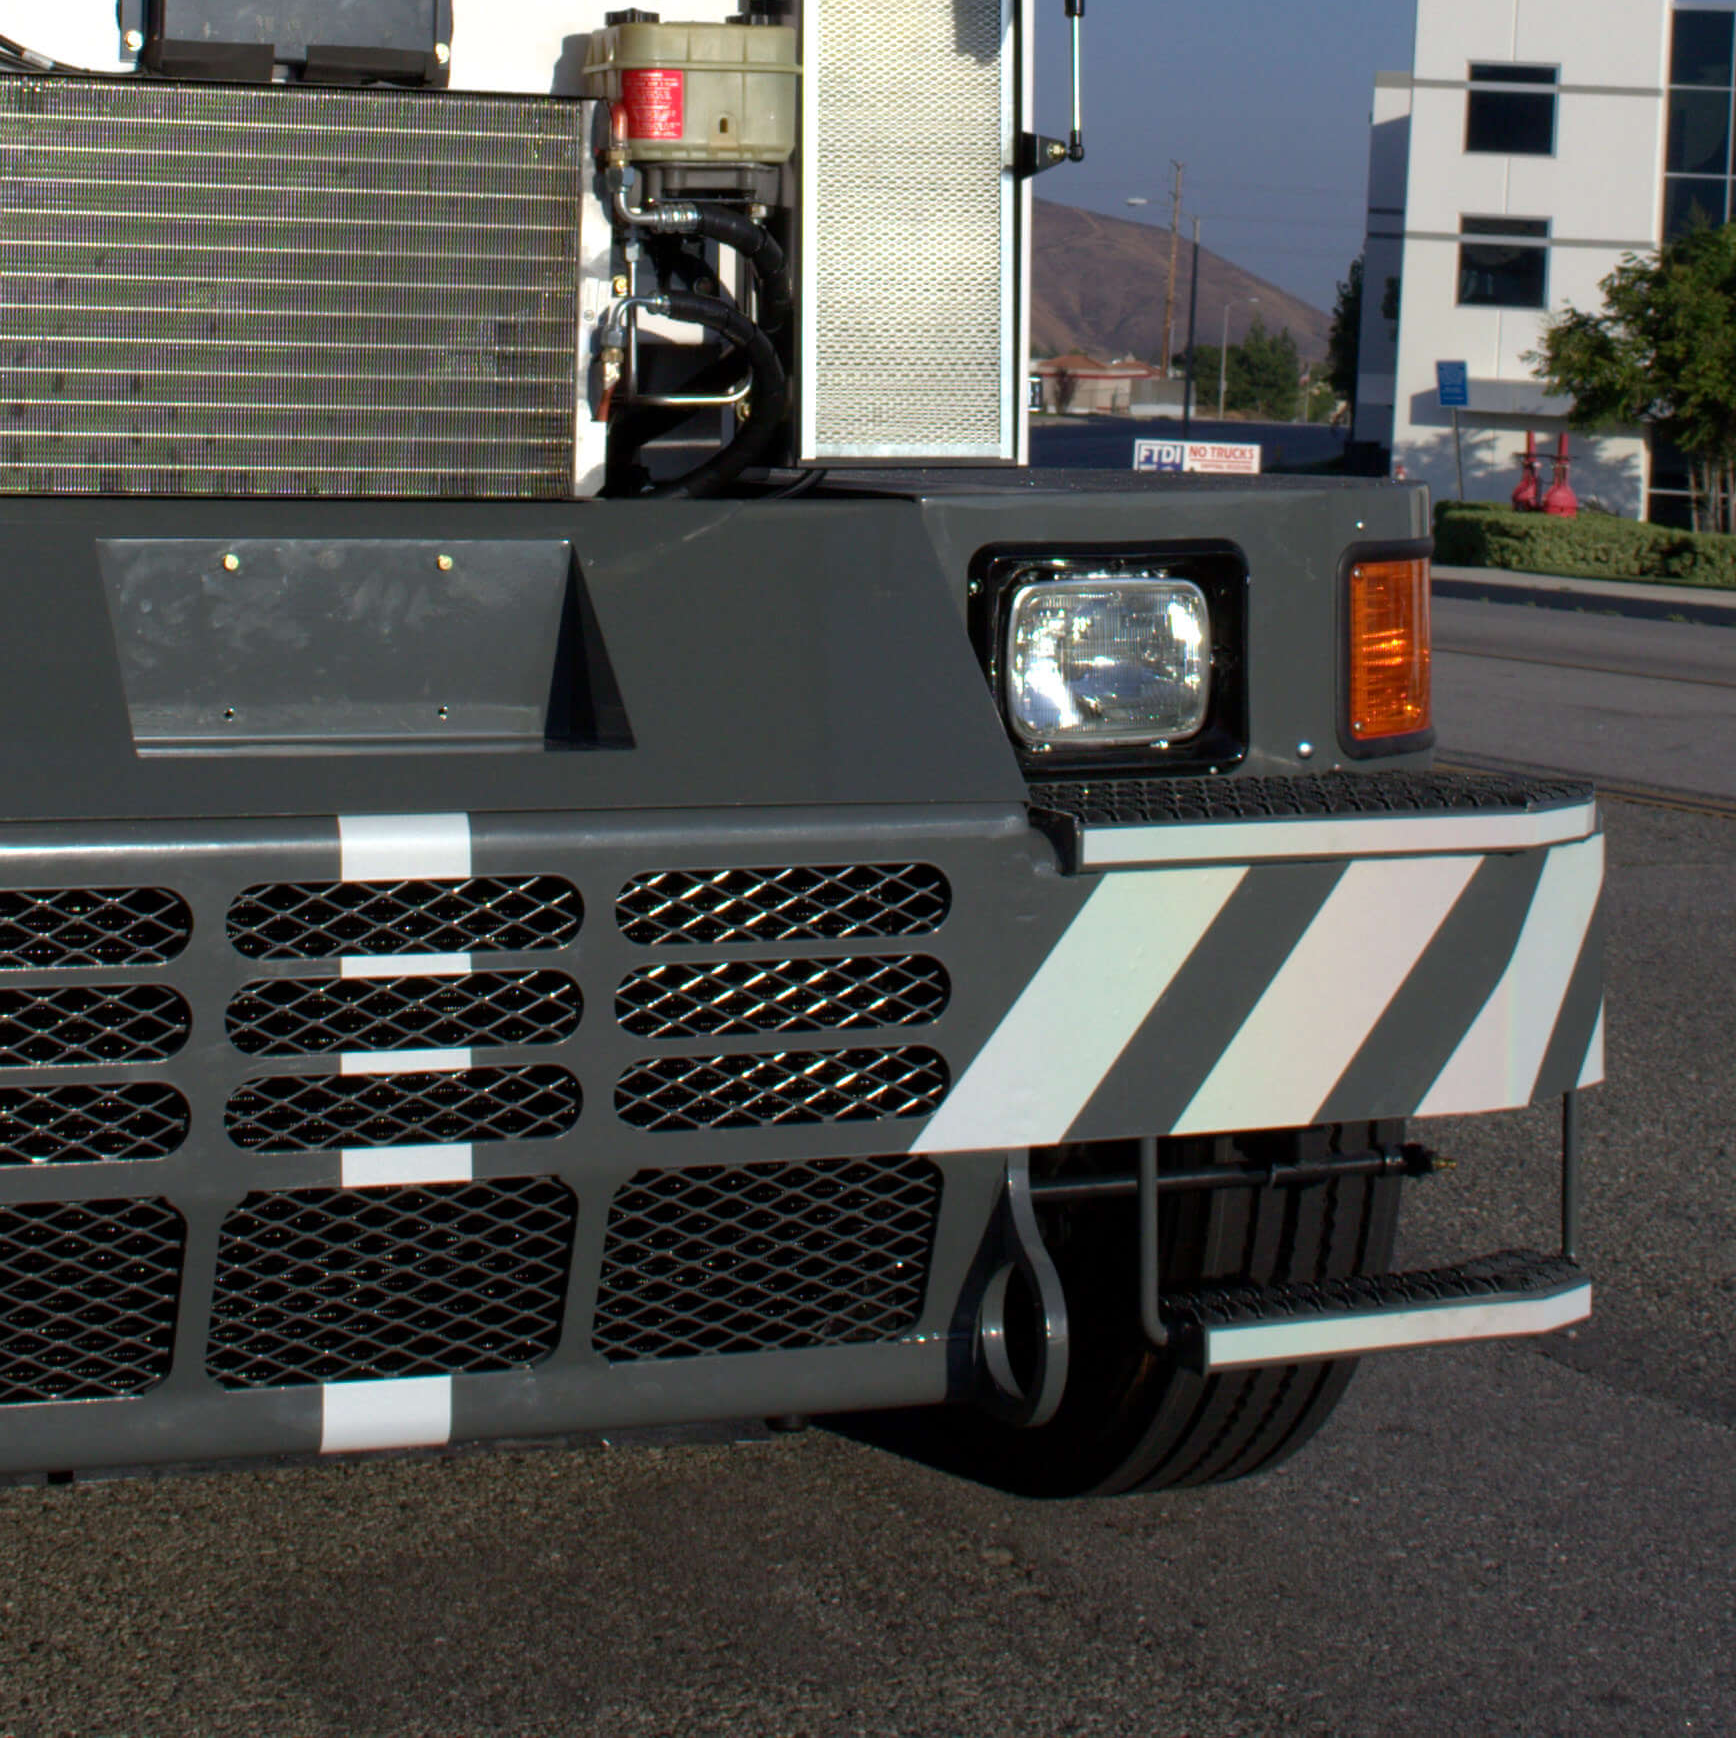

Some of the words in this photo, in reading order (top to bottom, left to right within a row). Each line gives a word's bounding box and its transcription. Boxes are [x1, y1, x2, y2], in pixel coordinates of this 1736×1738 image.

[1139, 444, 1183, 464] FTDI
[1189, 445, 1207, 458] NO
[1210, 446, 1254, 460] TRUCKS
